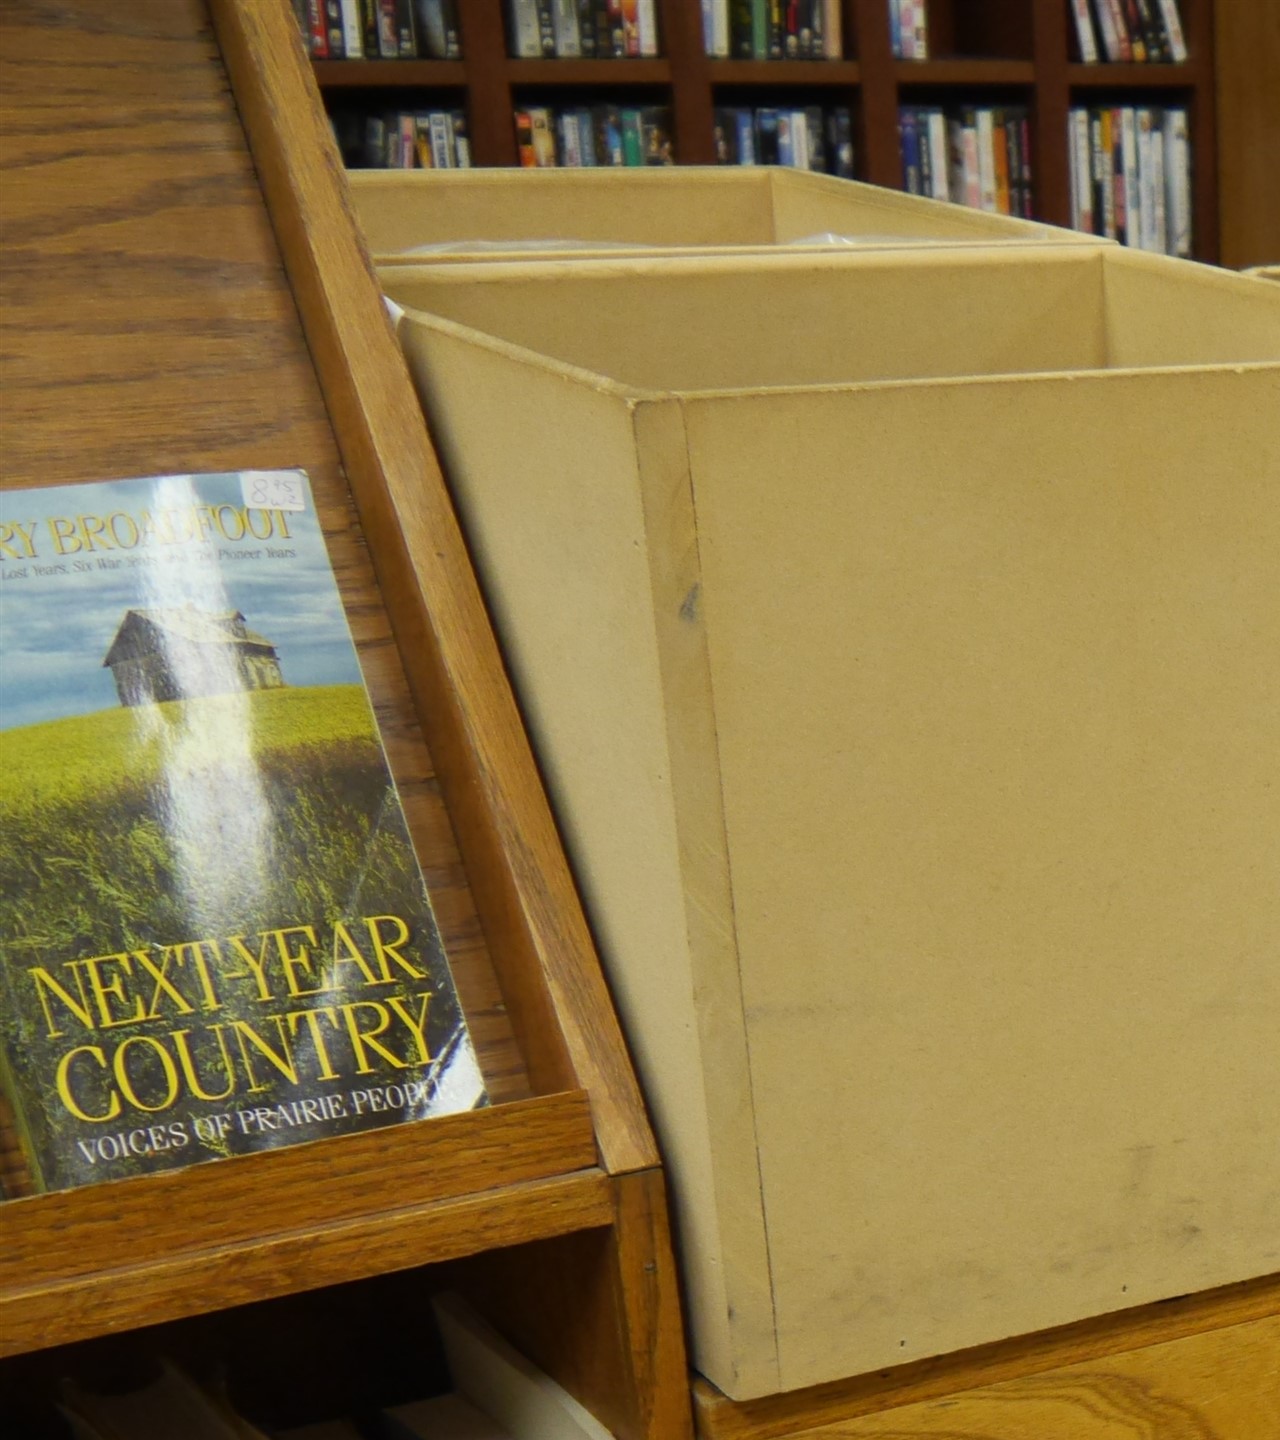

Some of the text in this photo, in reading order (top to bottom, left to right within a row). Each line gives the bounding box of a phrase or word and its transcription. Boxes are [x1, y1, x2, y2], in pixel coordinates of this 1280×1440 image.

[2, 567, 28, 580] Lost
[73, 559, 94, 572] Six
[218, 548, 262, 561] Pioneer
[265, 547, 297, 560] Years
[48, 505, 295, 554] BROADFOOT
[27, 914, 428, 1039] NEXT-YEAR
[55, 991, 436, 1124] COUNTRY
[76, 1121, 189, 1165] VOICES
[193, 1113, 234, 1142] OF
[238, 1094, 347, 1137] PRAIRIE
